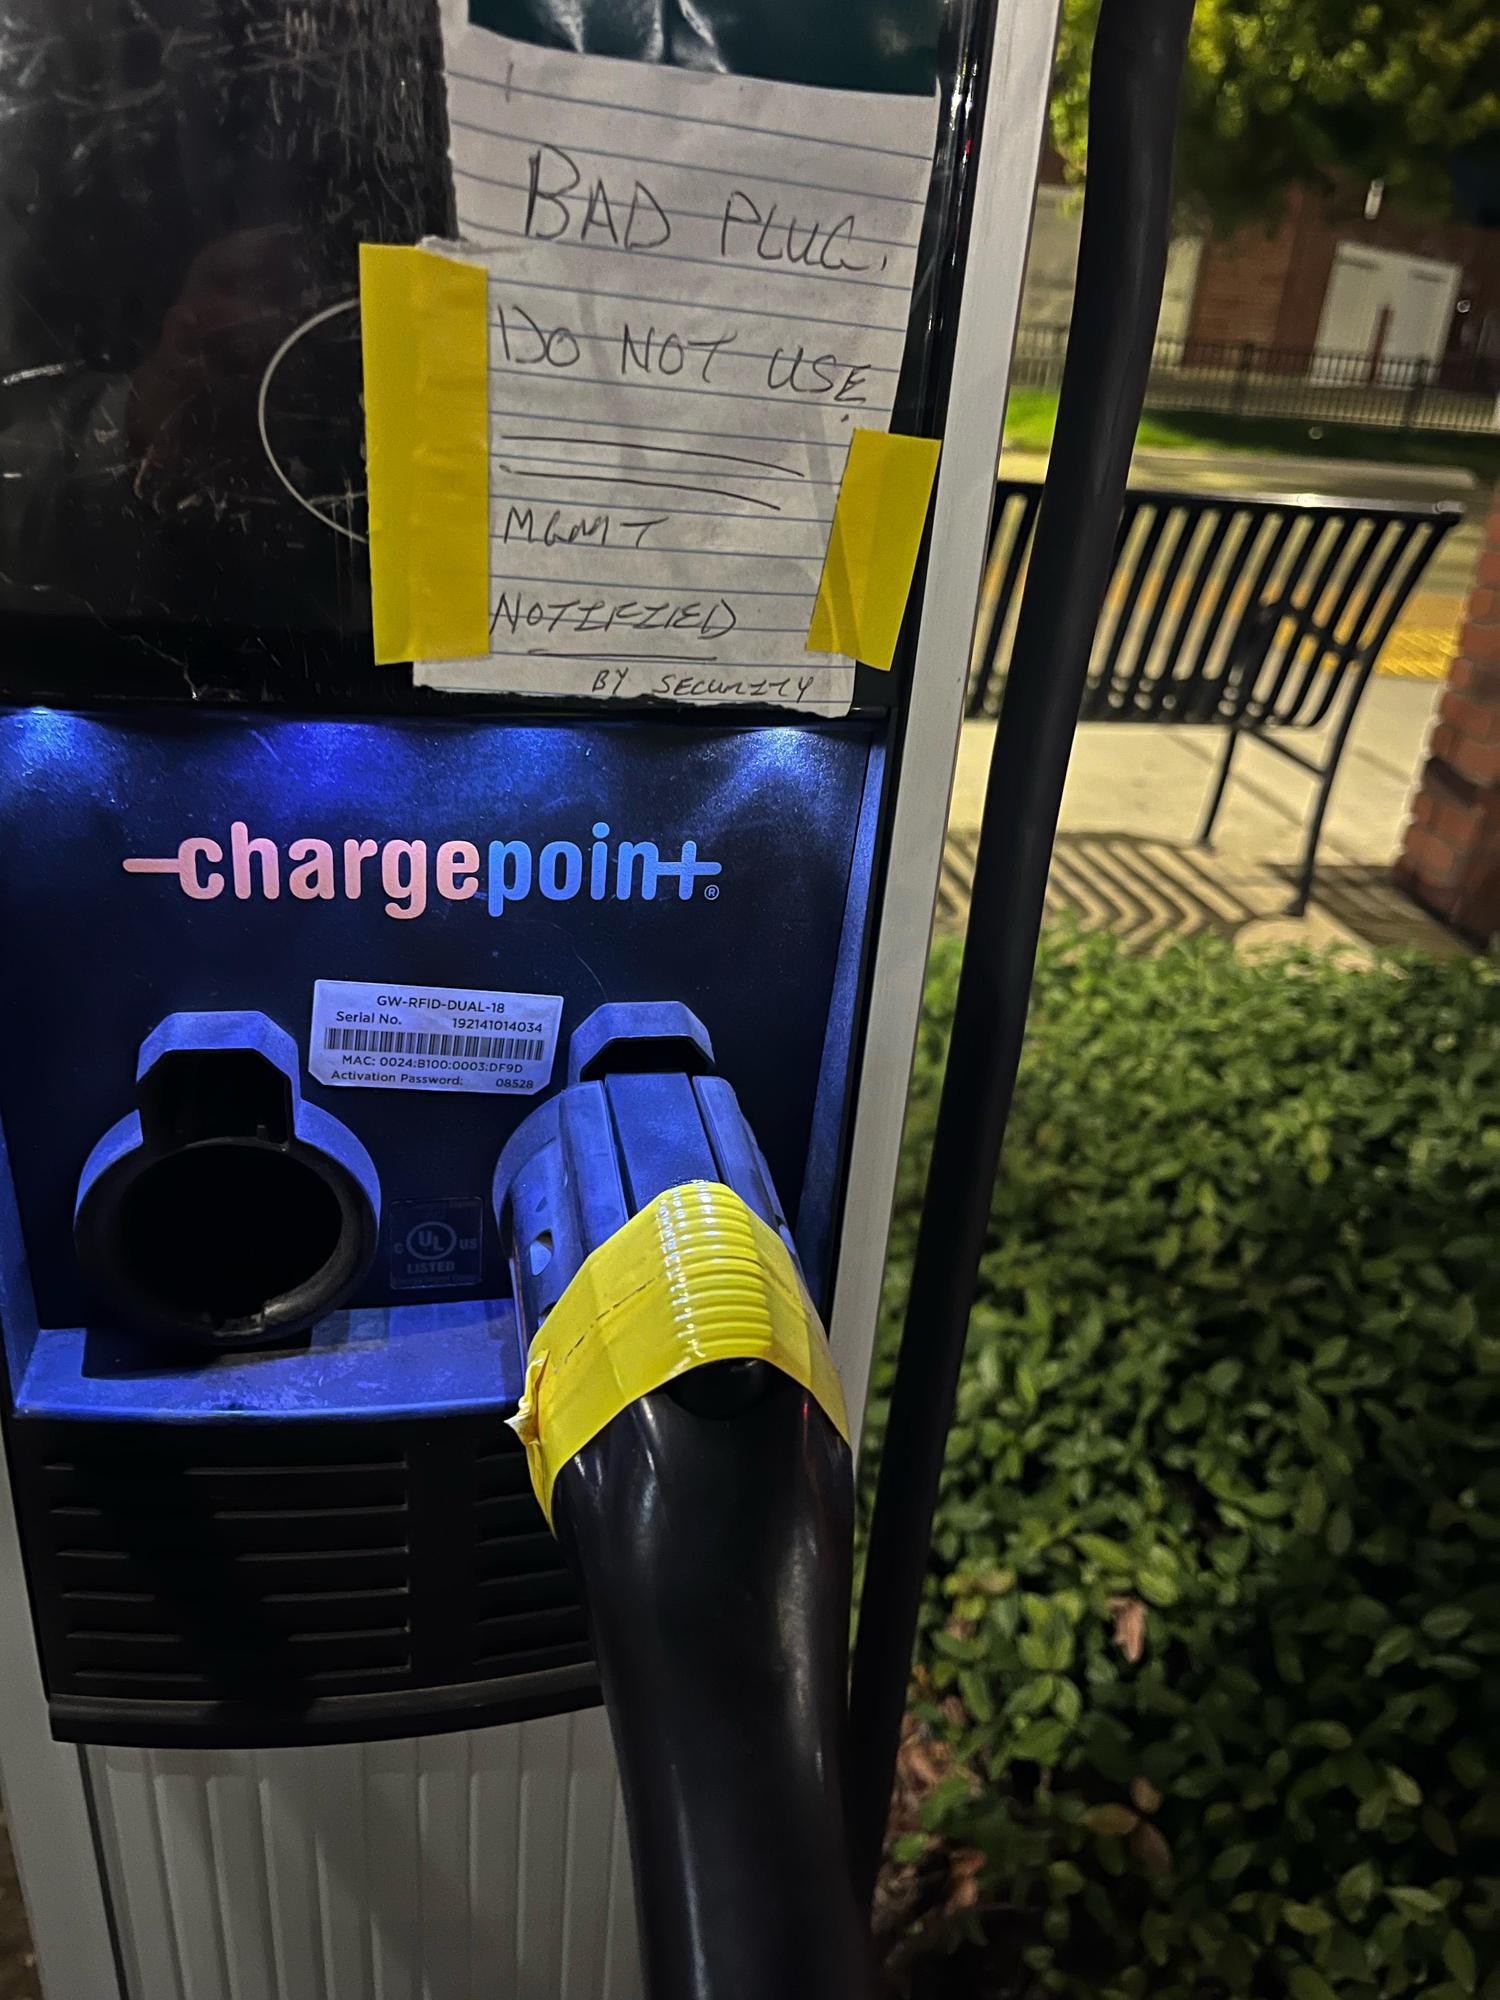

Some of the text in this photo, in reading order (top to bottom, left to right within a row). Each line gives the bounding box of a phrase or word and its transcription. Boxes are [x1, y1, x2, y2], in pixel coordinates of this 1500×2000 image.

[525, 143, 671, 249] BAD
[497, 304, 871, 402] DO NOT USE
[503, 506, 669, 548] MGMT
[489, 593, 737, 639] NOTIFIED
[592, 667, 814, 703] BY SECURITY
[377, 995, 505, 1013] GW-RFID-DUAL-18
[336, 1011, 543, 1033] Serial No. 192141014034
[342, 1055, 523, 1074] MAC: 0024:B100:0003:DF9D
[331, 1070, 534, 1089] Activation Password: 08528
[418, 1230, 444, 1251] UL
[407, 1260, 456, 1275] LISTED
